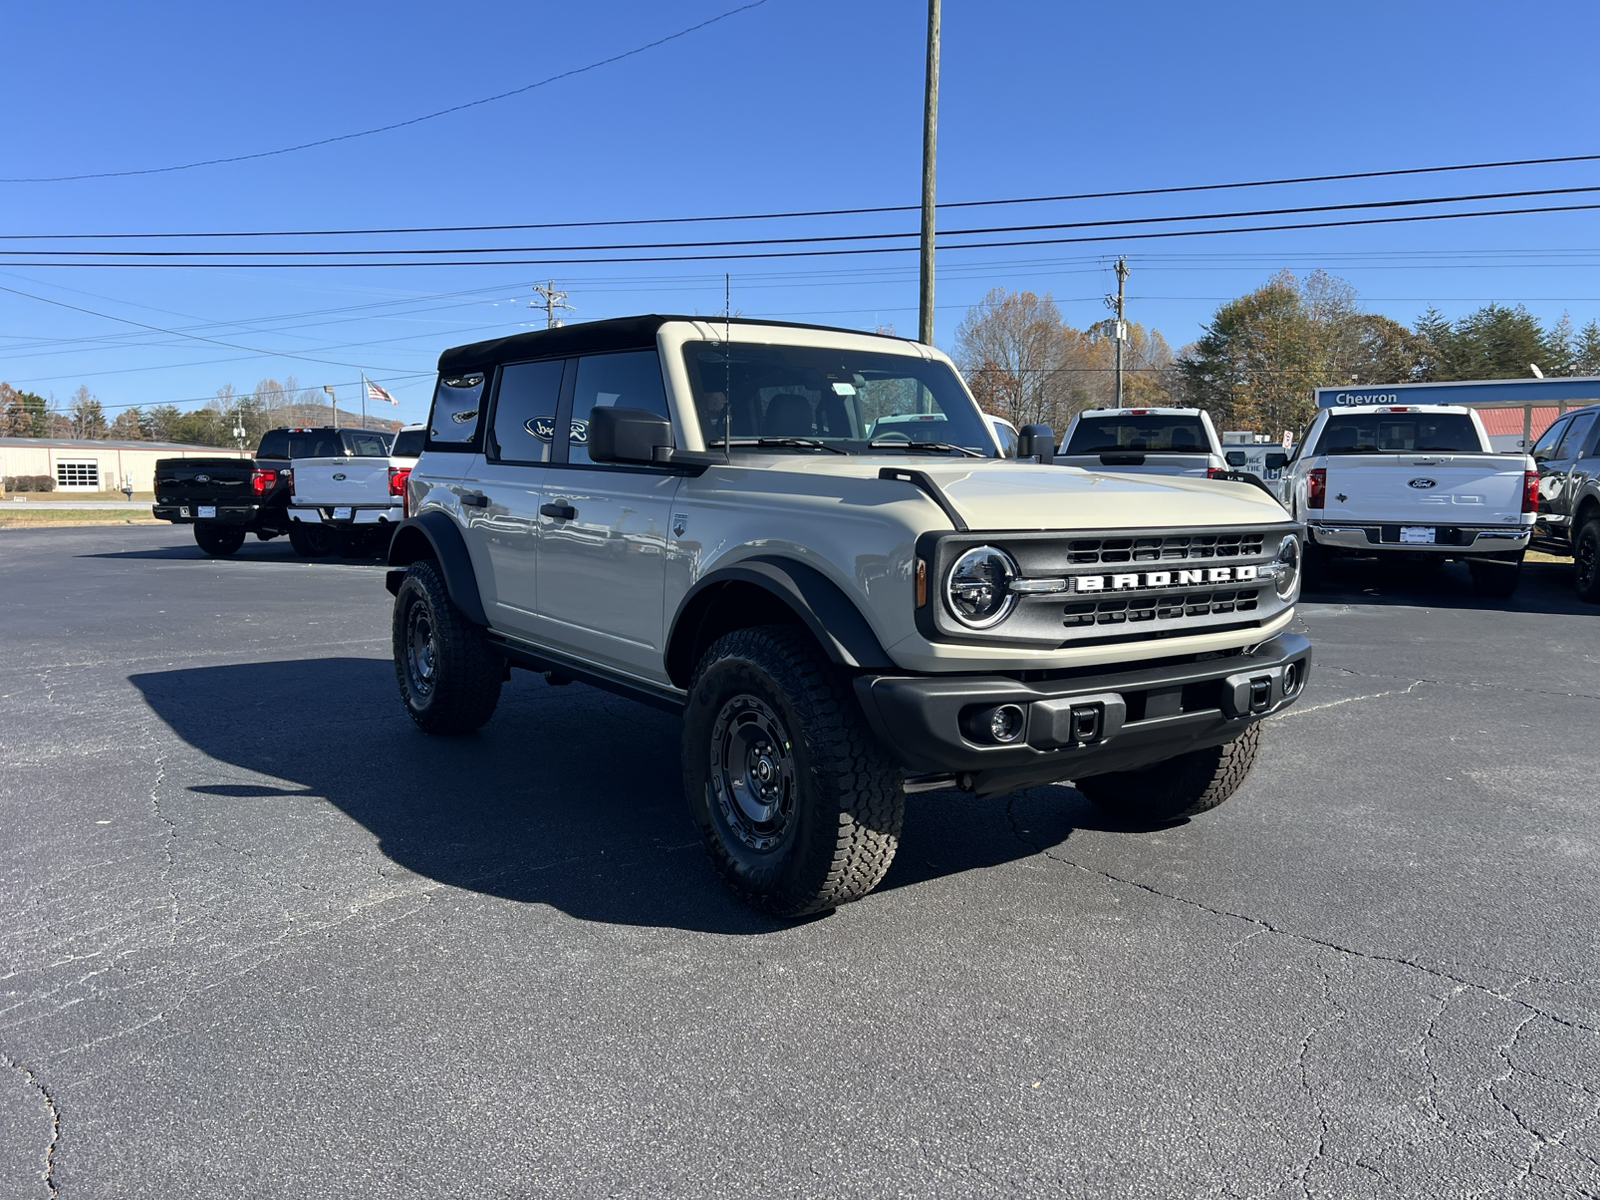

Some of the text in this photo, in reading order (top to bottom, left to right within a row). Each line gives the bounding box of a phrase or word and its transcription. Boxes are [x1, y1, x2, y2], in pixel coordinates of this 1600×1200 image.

[1336, 393, 1397, 405] Chevron
[1411, 478, 1433, 488] Ford
[1075, 565, 1258, 591] BRONCO
